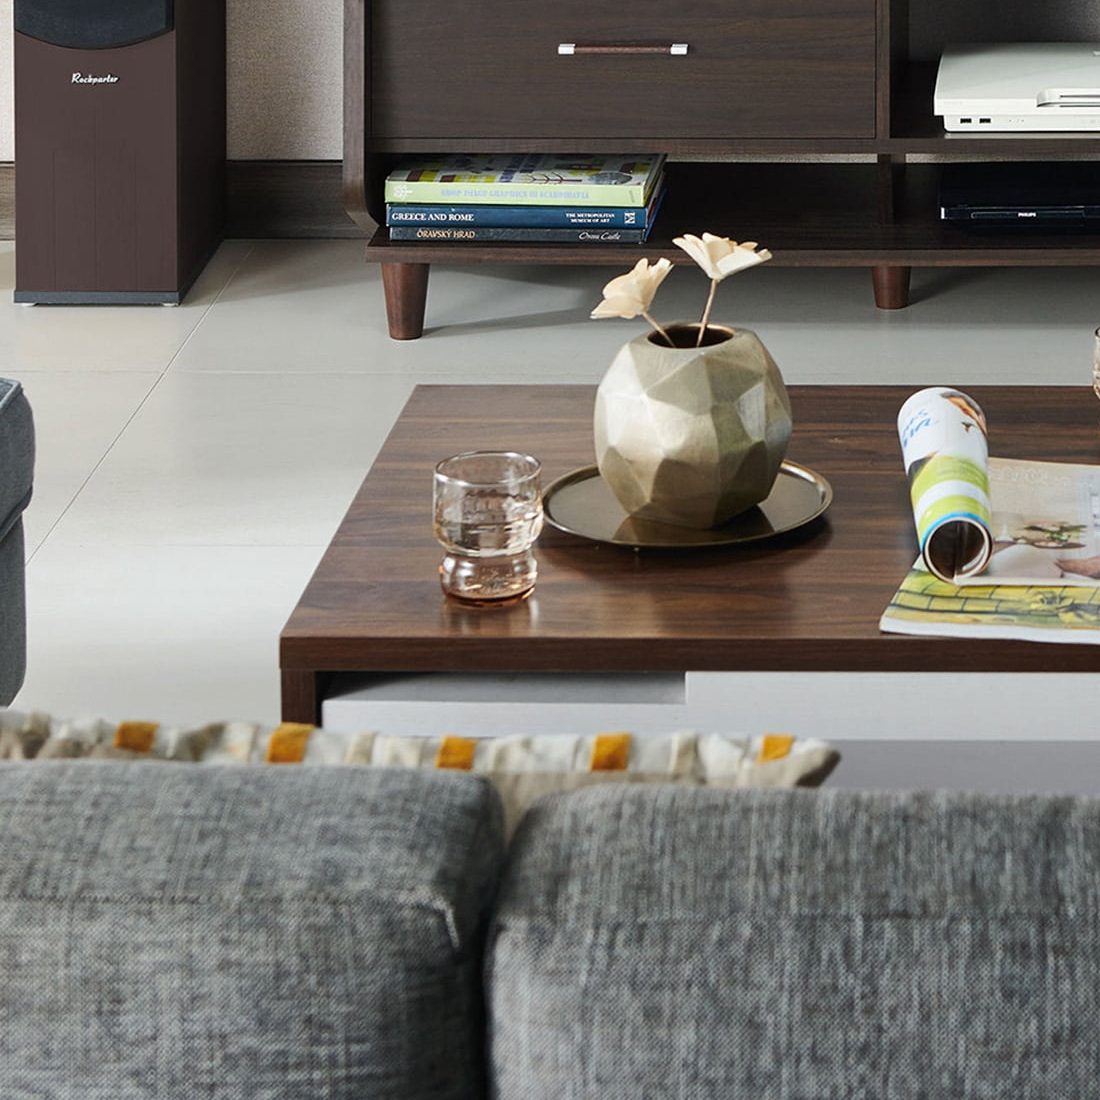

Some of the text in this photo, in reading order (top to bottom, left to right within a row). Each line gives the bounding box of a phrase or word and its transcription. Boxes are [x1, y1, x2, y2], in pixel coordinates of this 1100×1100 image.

[392, 212, 474, 222] GREECE AND ROME
